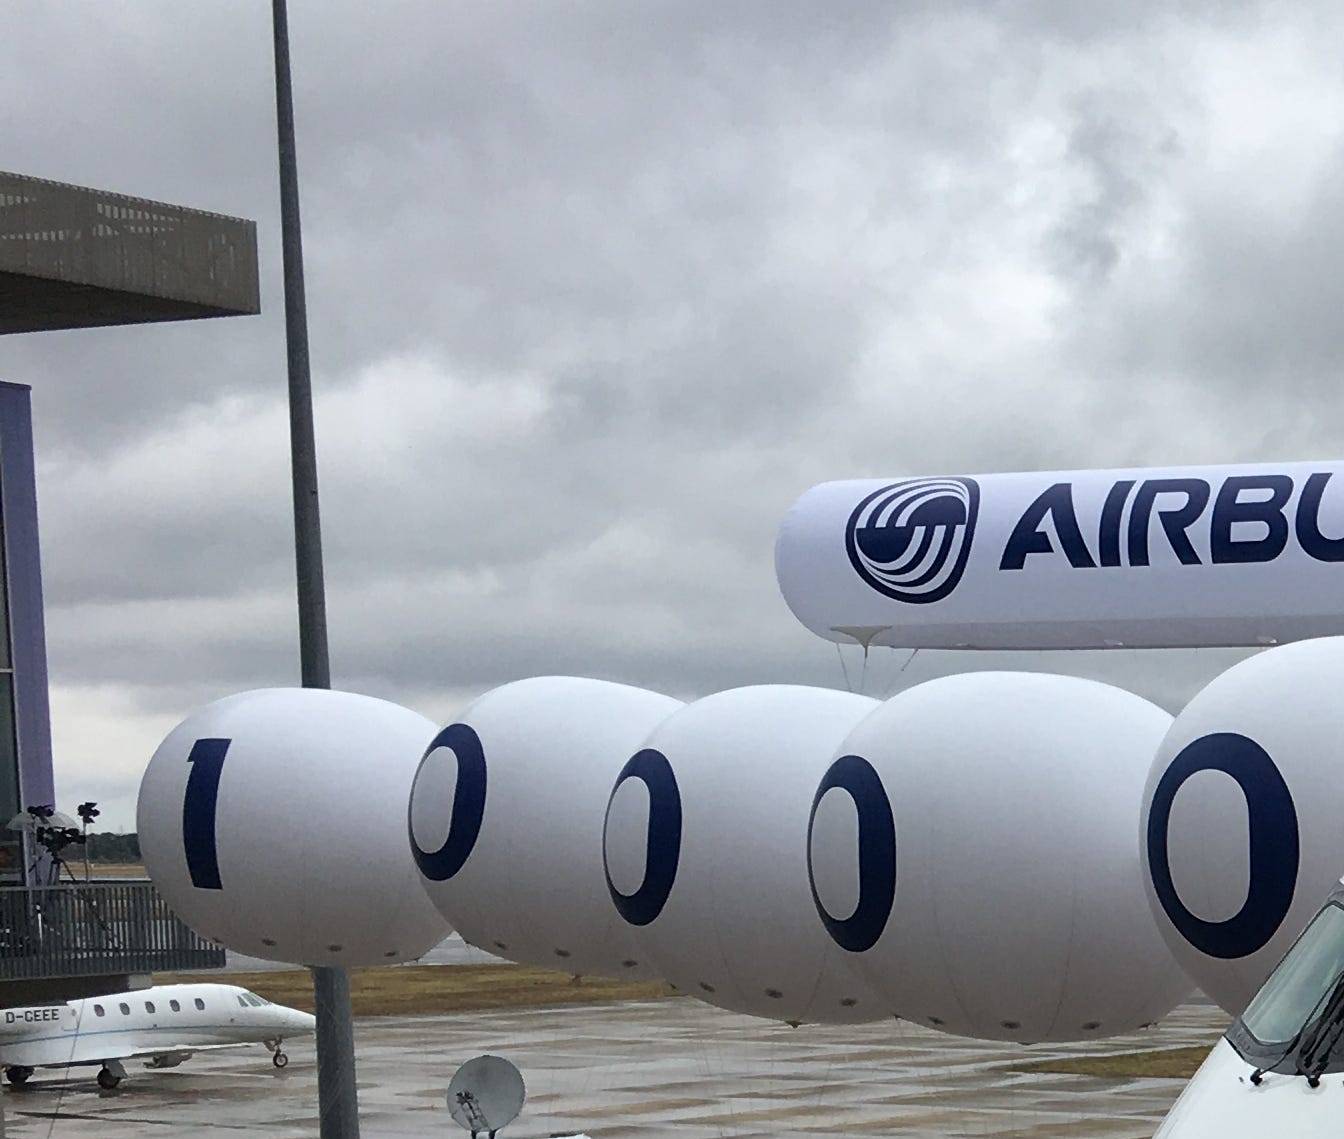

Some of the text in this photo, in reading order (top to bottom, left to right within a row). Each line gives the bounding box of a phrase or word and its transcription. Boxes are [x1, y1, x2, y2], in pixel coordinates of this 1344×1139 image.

[182, 722, 1300, 960] 1 0 0 0 0
